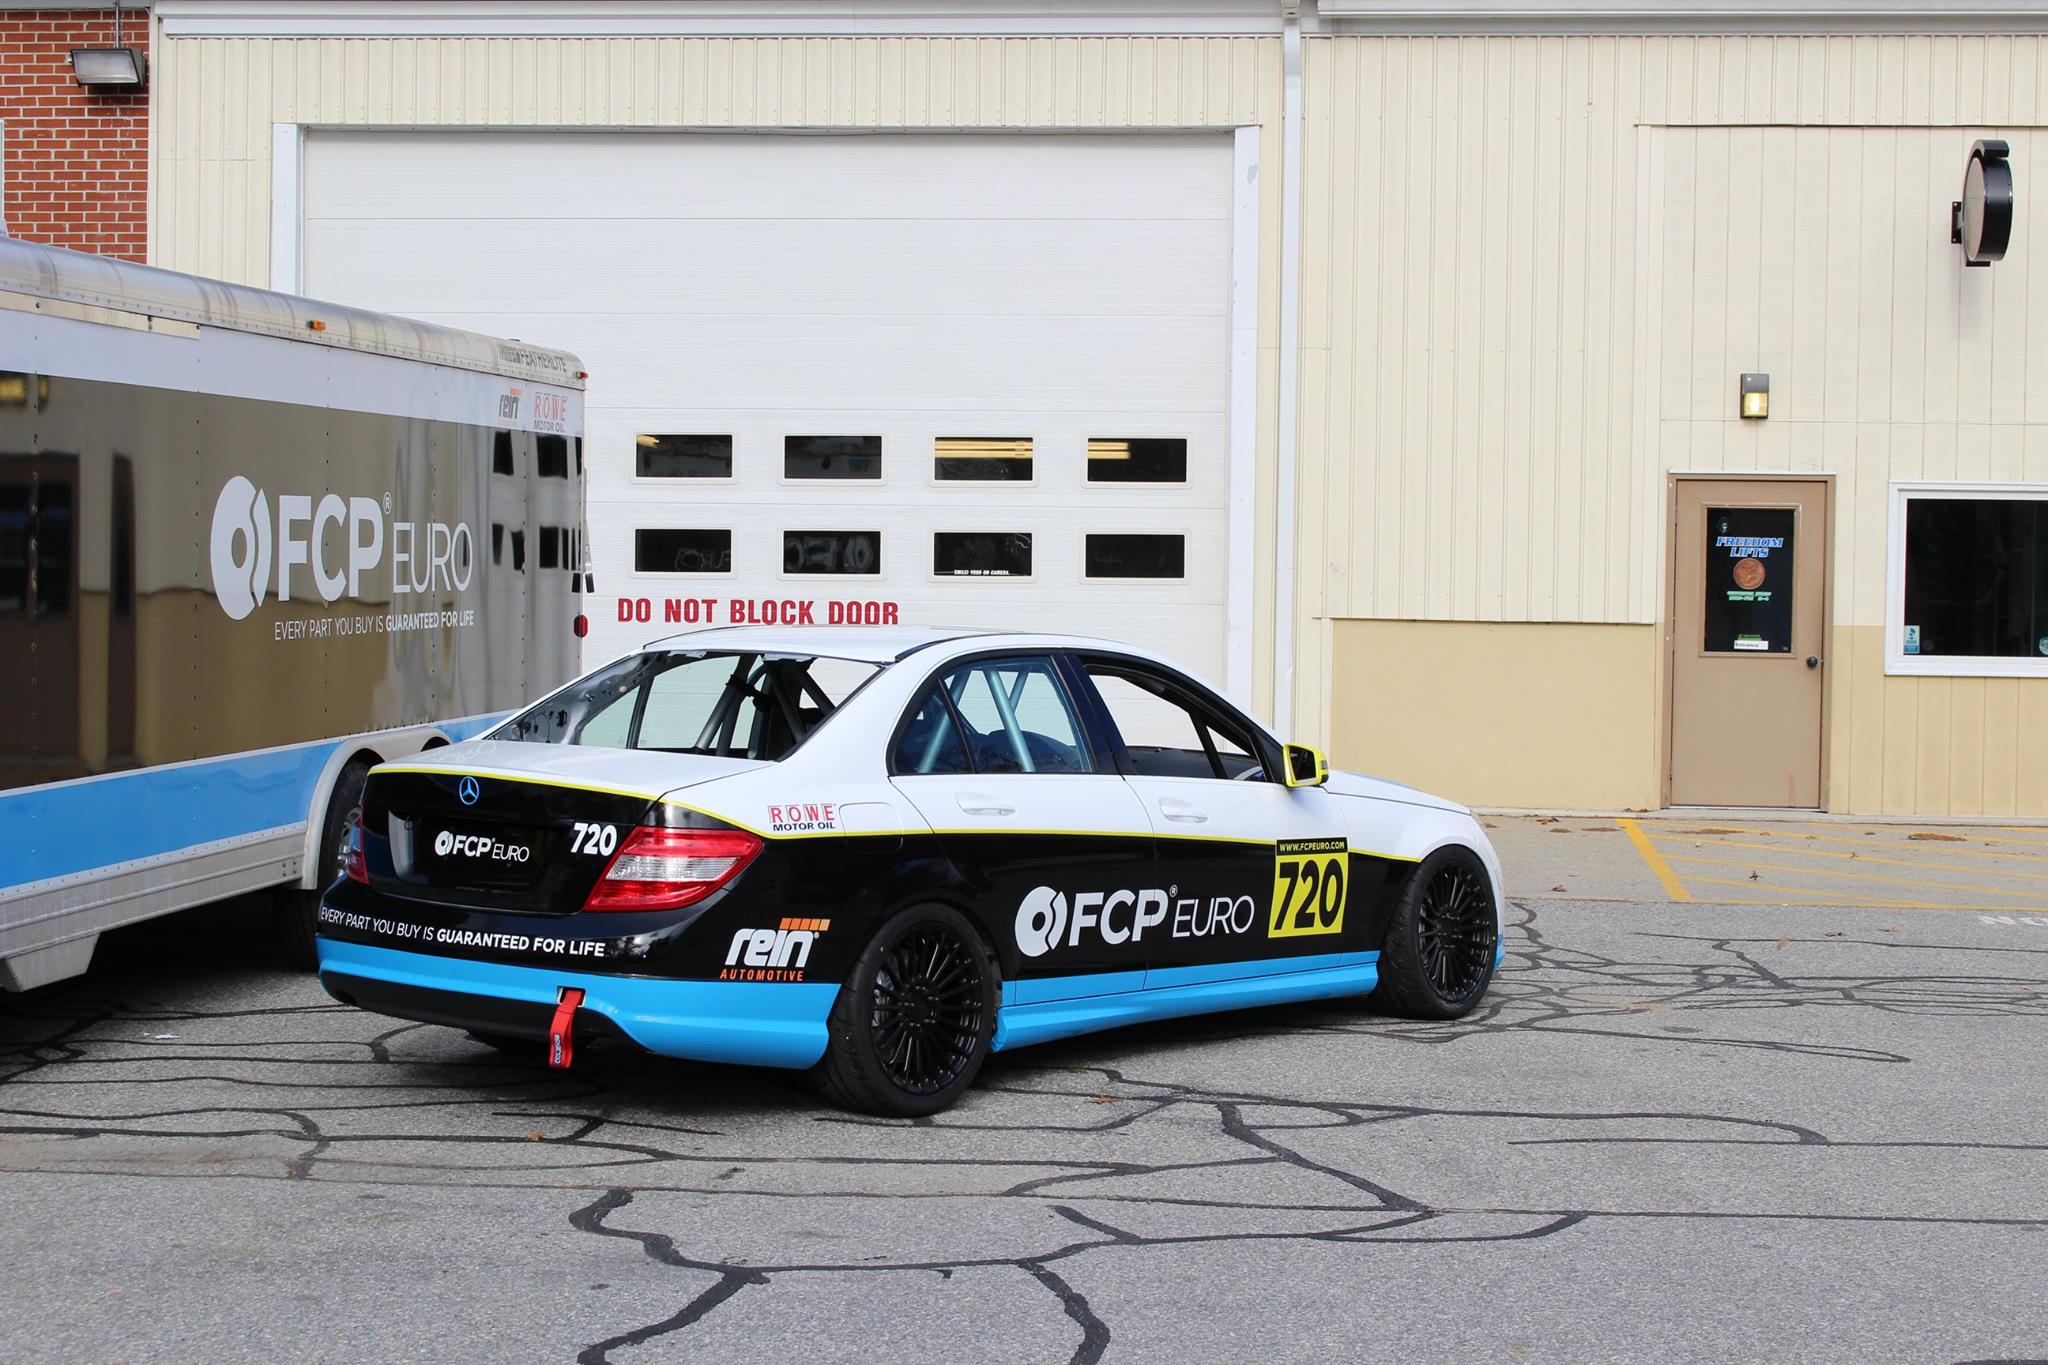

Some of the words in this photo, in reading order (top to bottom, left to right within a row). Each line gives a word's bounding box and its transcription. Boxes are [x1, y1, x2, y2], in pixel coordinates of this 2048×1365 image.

[519, 348, 568, 373] FEATHERLITE
[535, 393, 567, 421] ROWE
[534, 419, 555, 431] MOTOR
[555, 423, 566, 433] OIL
[278, 493, 384, 602] FCP
[393, 521, 473, 594] EURO
[1716, 536, 1784, 547] FREEDOM
[1730, 547, 1769, 557] LIFTS
[618, 597, 651, 623] DO
[664, 598, 718, 623] NOT
[730, 599, 815, 625] BLOCK
[828, 600, 899, 625] DOOR
[274, 620, 308, 641] EVERY
[309, 618, 333, 638] PART
[335, 616, 354, 636] YOU
[355, 615, 375, 634] BUY
[375, 615, 384, 632] IS
[386, 611, 440, 632] GUARANTEED
[440, 611, 458, 628] FOR
[459, 610, 475, 627] LIFE
[768, 804, 836, 823] ROWE
[773, 821, 814, 832] MOTOR
[817, 821, 835, 830] OIL
[453, 834, 491, 858] FCP
[491, 843, 529, 862] EURO
[570, 822, 617, 857] 720
[1279, 841, 1345, 852] WWW.FCPEURO.COM
[1273, 858, 1344, 931] 720
[320, 906, 346, 925] EVERY
[346, 912, 371, 931] PART
[373, 917, 397, 935] YOU
[397, 922, 422, 939] BUY
[423, 926, 435, 941] IS
[436, 928, 530, 950] GUARANTEED
[533, 937, 566, 954] FOR
[569, 941, 606, 957] LIFE
[1069, 889, 1168, 946] FCP
[1172, 895, 1255, 938] EURO
[724, 928, 814, 968] rein
[720, 968, 804, 981] AUTOMOTIVE
